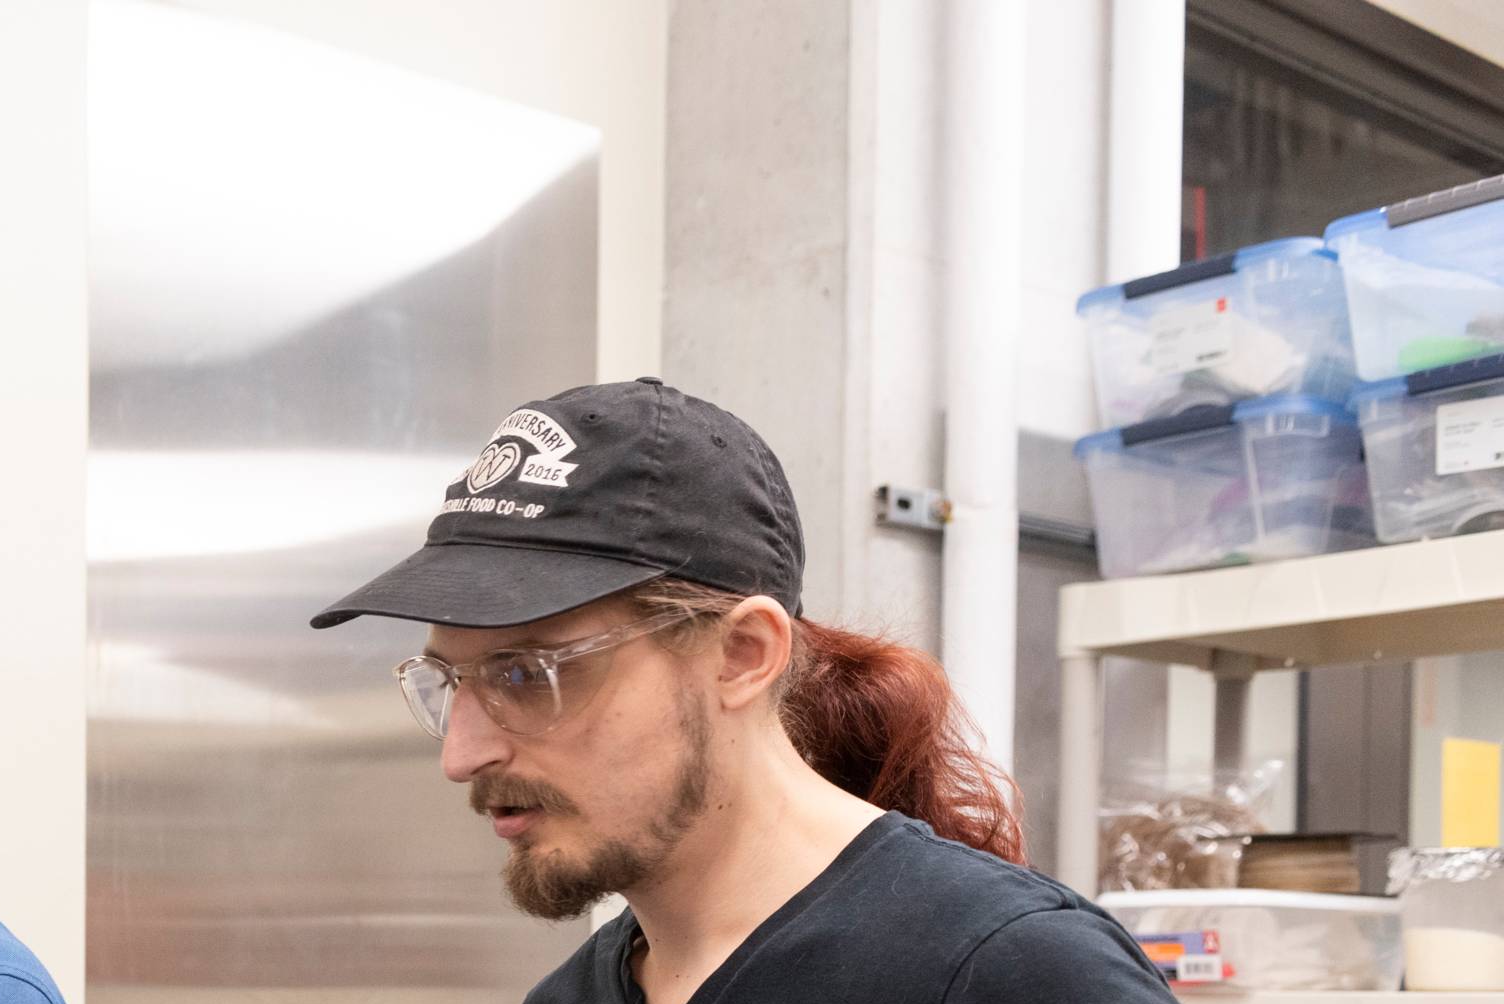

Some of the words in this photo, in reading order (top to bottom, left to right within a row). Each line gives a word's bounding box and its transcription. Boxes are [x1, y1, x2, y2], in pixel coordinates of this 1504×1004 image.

[525, 463, 562, 481] 2016
[467, 498, 496, 512] FOOD
[496, 500, 545, 518] CO-OP
